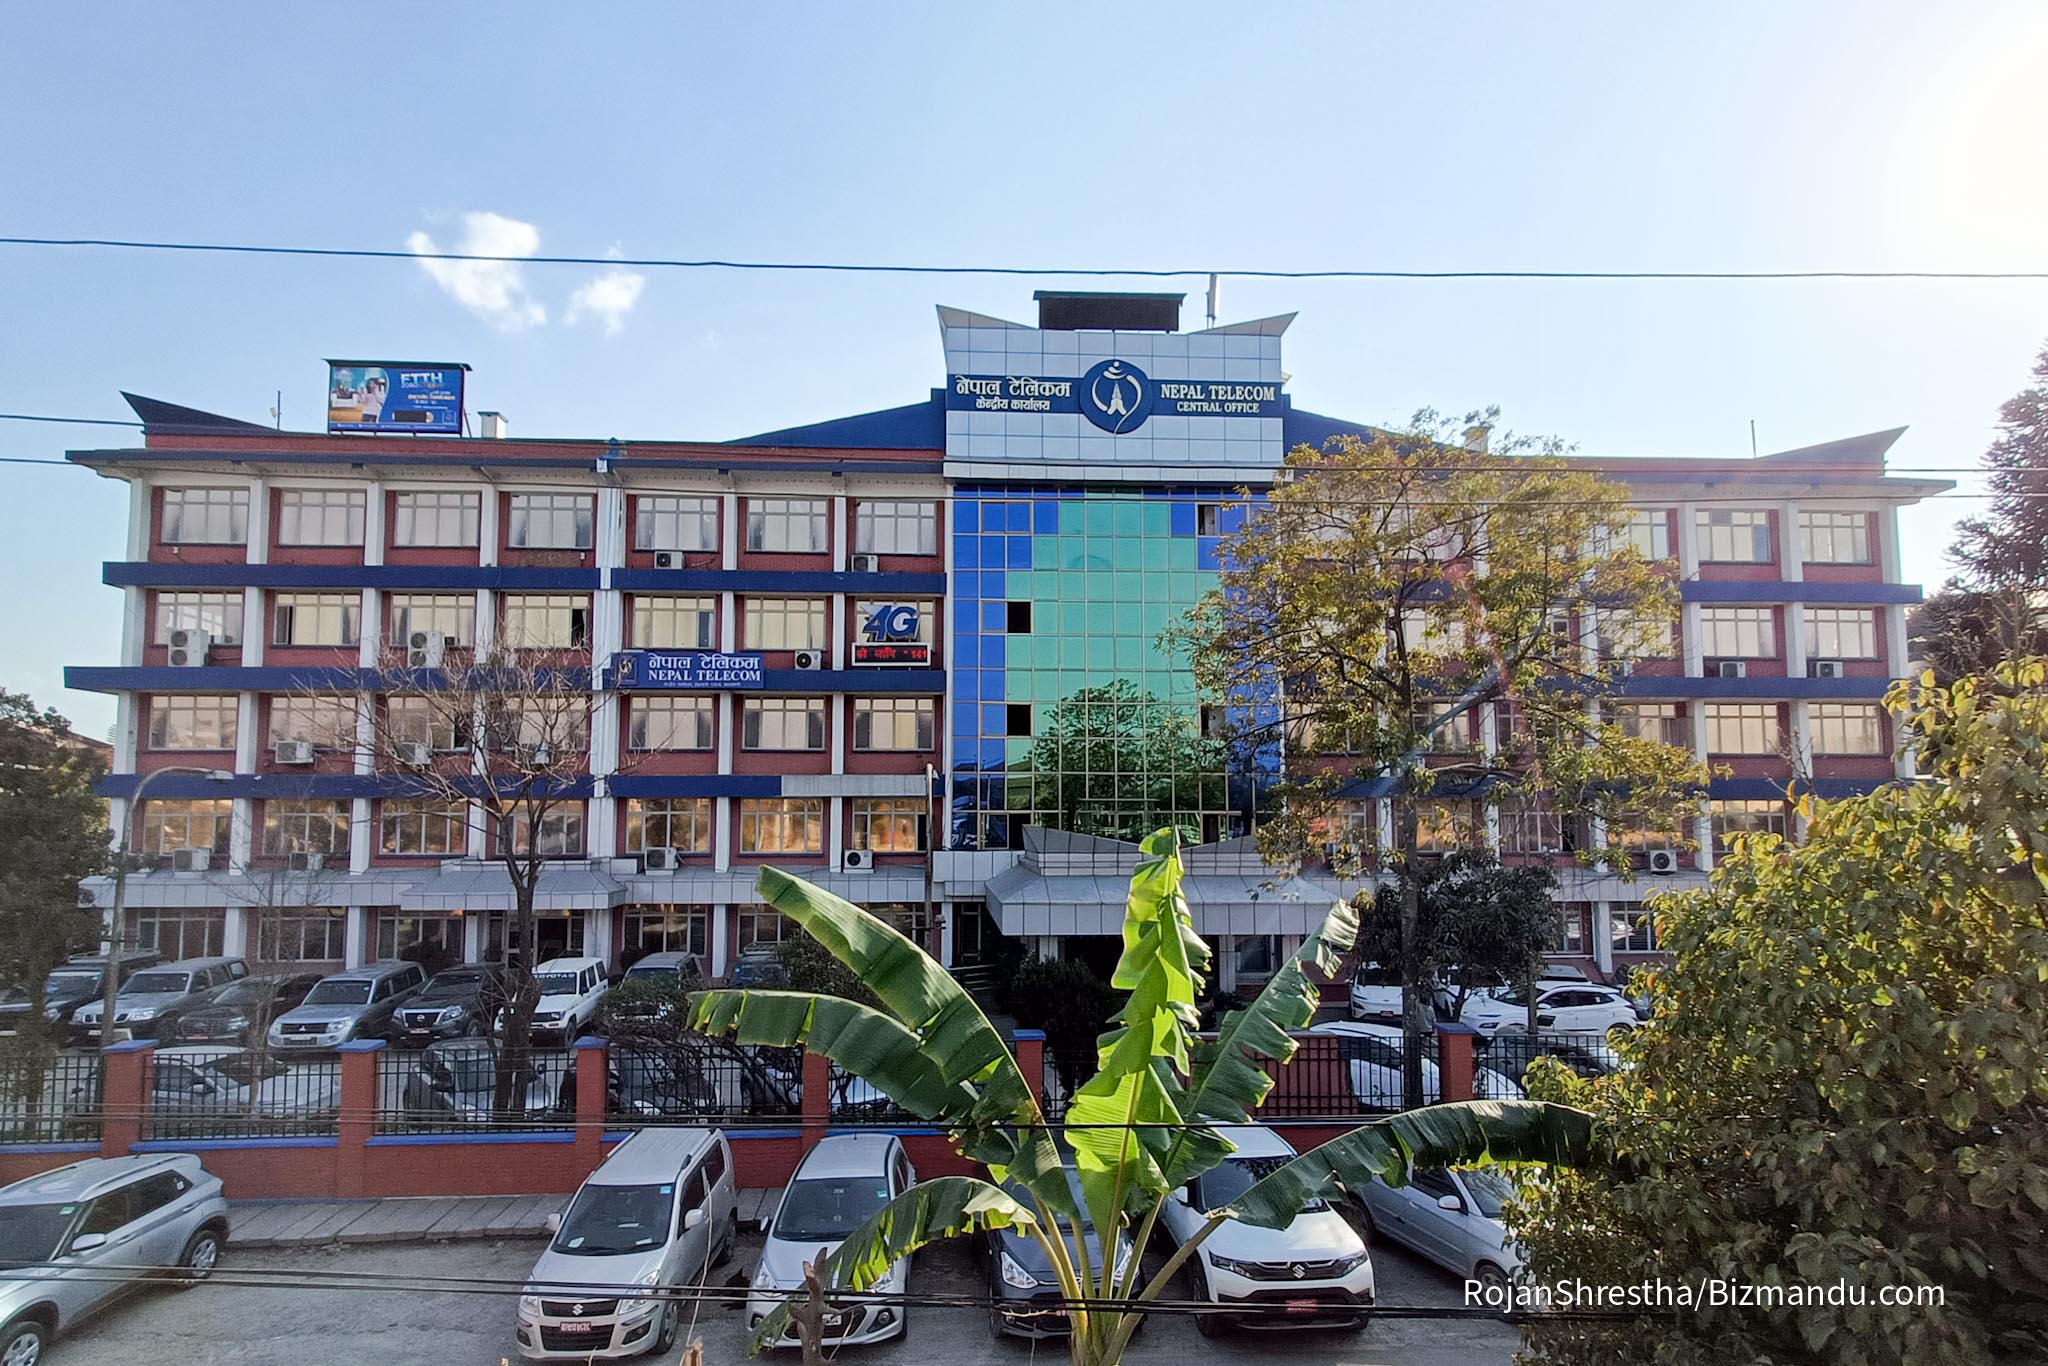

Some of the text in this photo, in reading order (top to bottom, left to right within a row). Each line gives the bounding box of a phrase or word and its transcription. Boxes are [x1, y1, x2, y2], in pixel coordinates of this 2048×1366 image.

[401, 372, 442, 384] FTTH
[955, 375, 1072, 397] नेपाल टेलिकम
[1161, 384, 1275, 401] NEPAL TELECOM
[976, 396, 1051, 411] केन्द्रीय कार्यालय
[1177, 402, 1260, 413] CENTRAL OFFICE
[863, 604, 920, 641] 4G
[648, 653, 760, 669] नेपाल टेलिकम
[648, 670, 761, 682] NEPAL TELECOM
